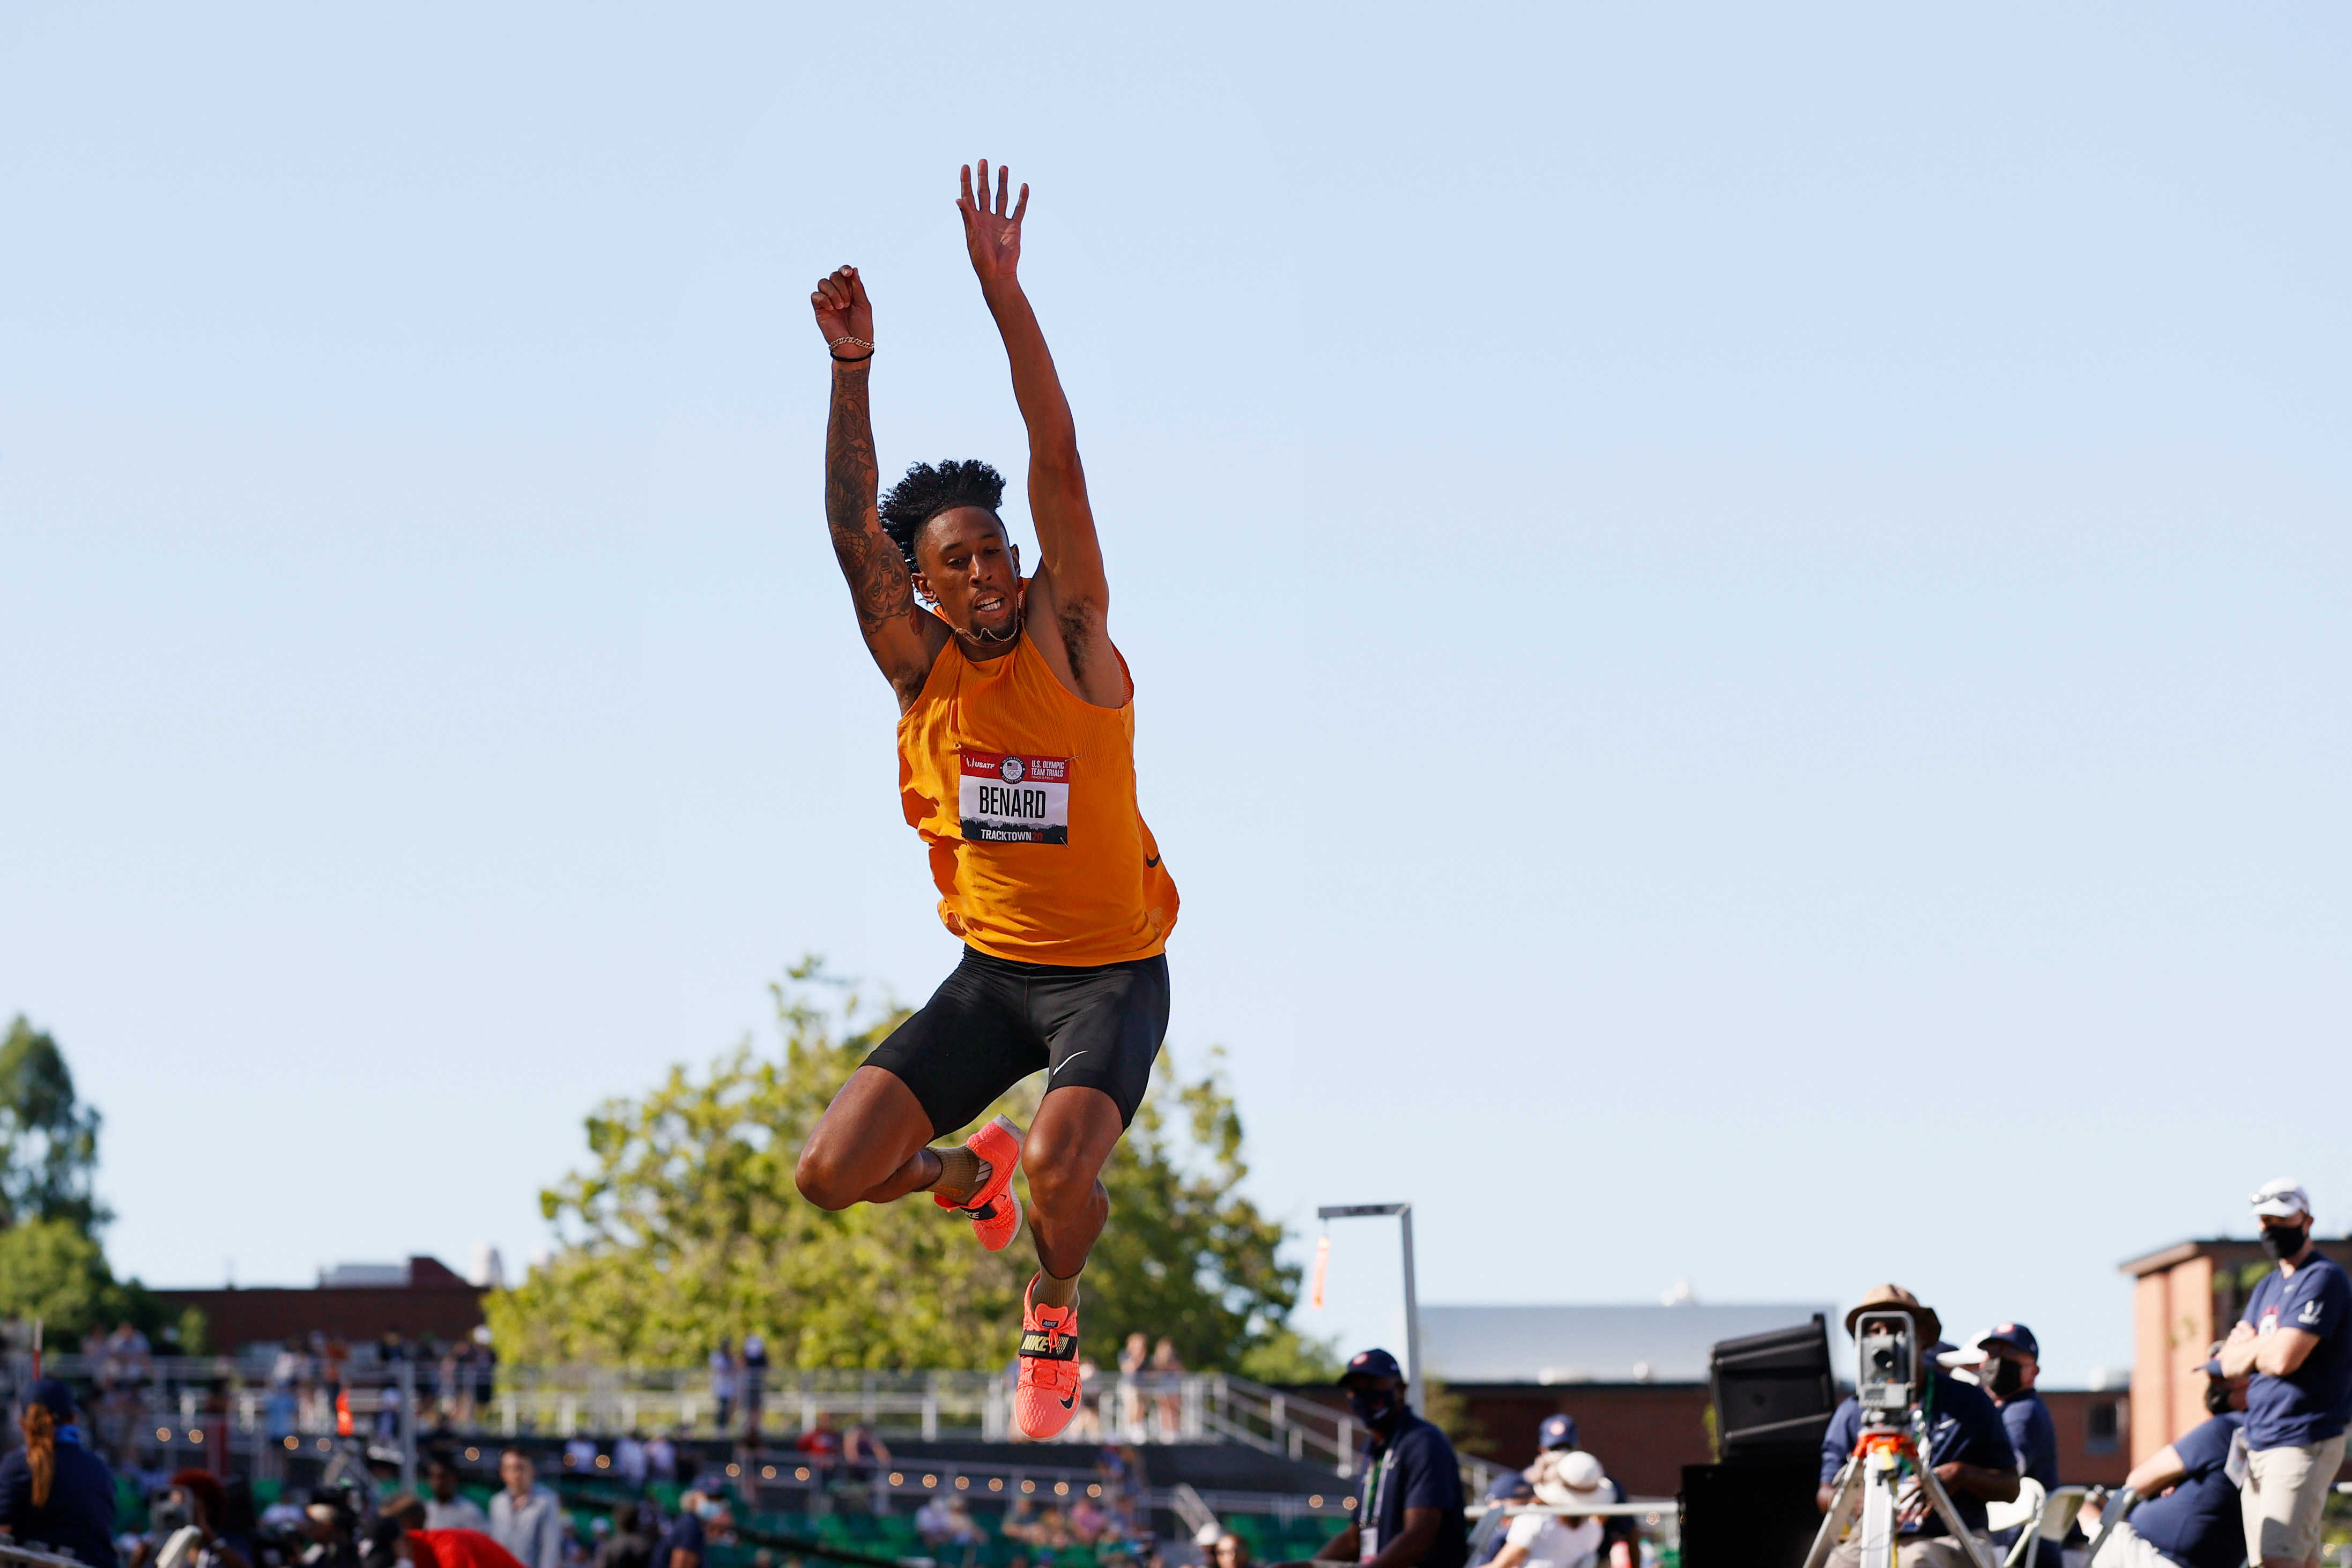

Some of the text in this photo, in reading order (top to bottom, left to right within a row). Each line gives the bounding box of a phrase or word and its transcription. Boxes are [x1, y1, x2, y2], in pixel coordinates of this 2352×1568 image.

[1032, 760, 1064, 769] U.S. OLYMPIC
[1031, 768, 1064, 777] TEAM TRIALS
[979, 785, 1046, 819] BENARD
[1021, 1334, 1049, 1352] NIKE
